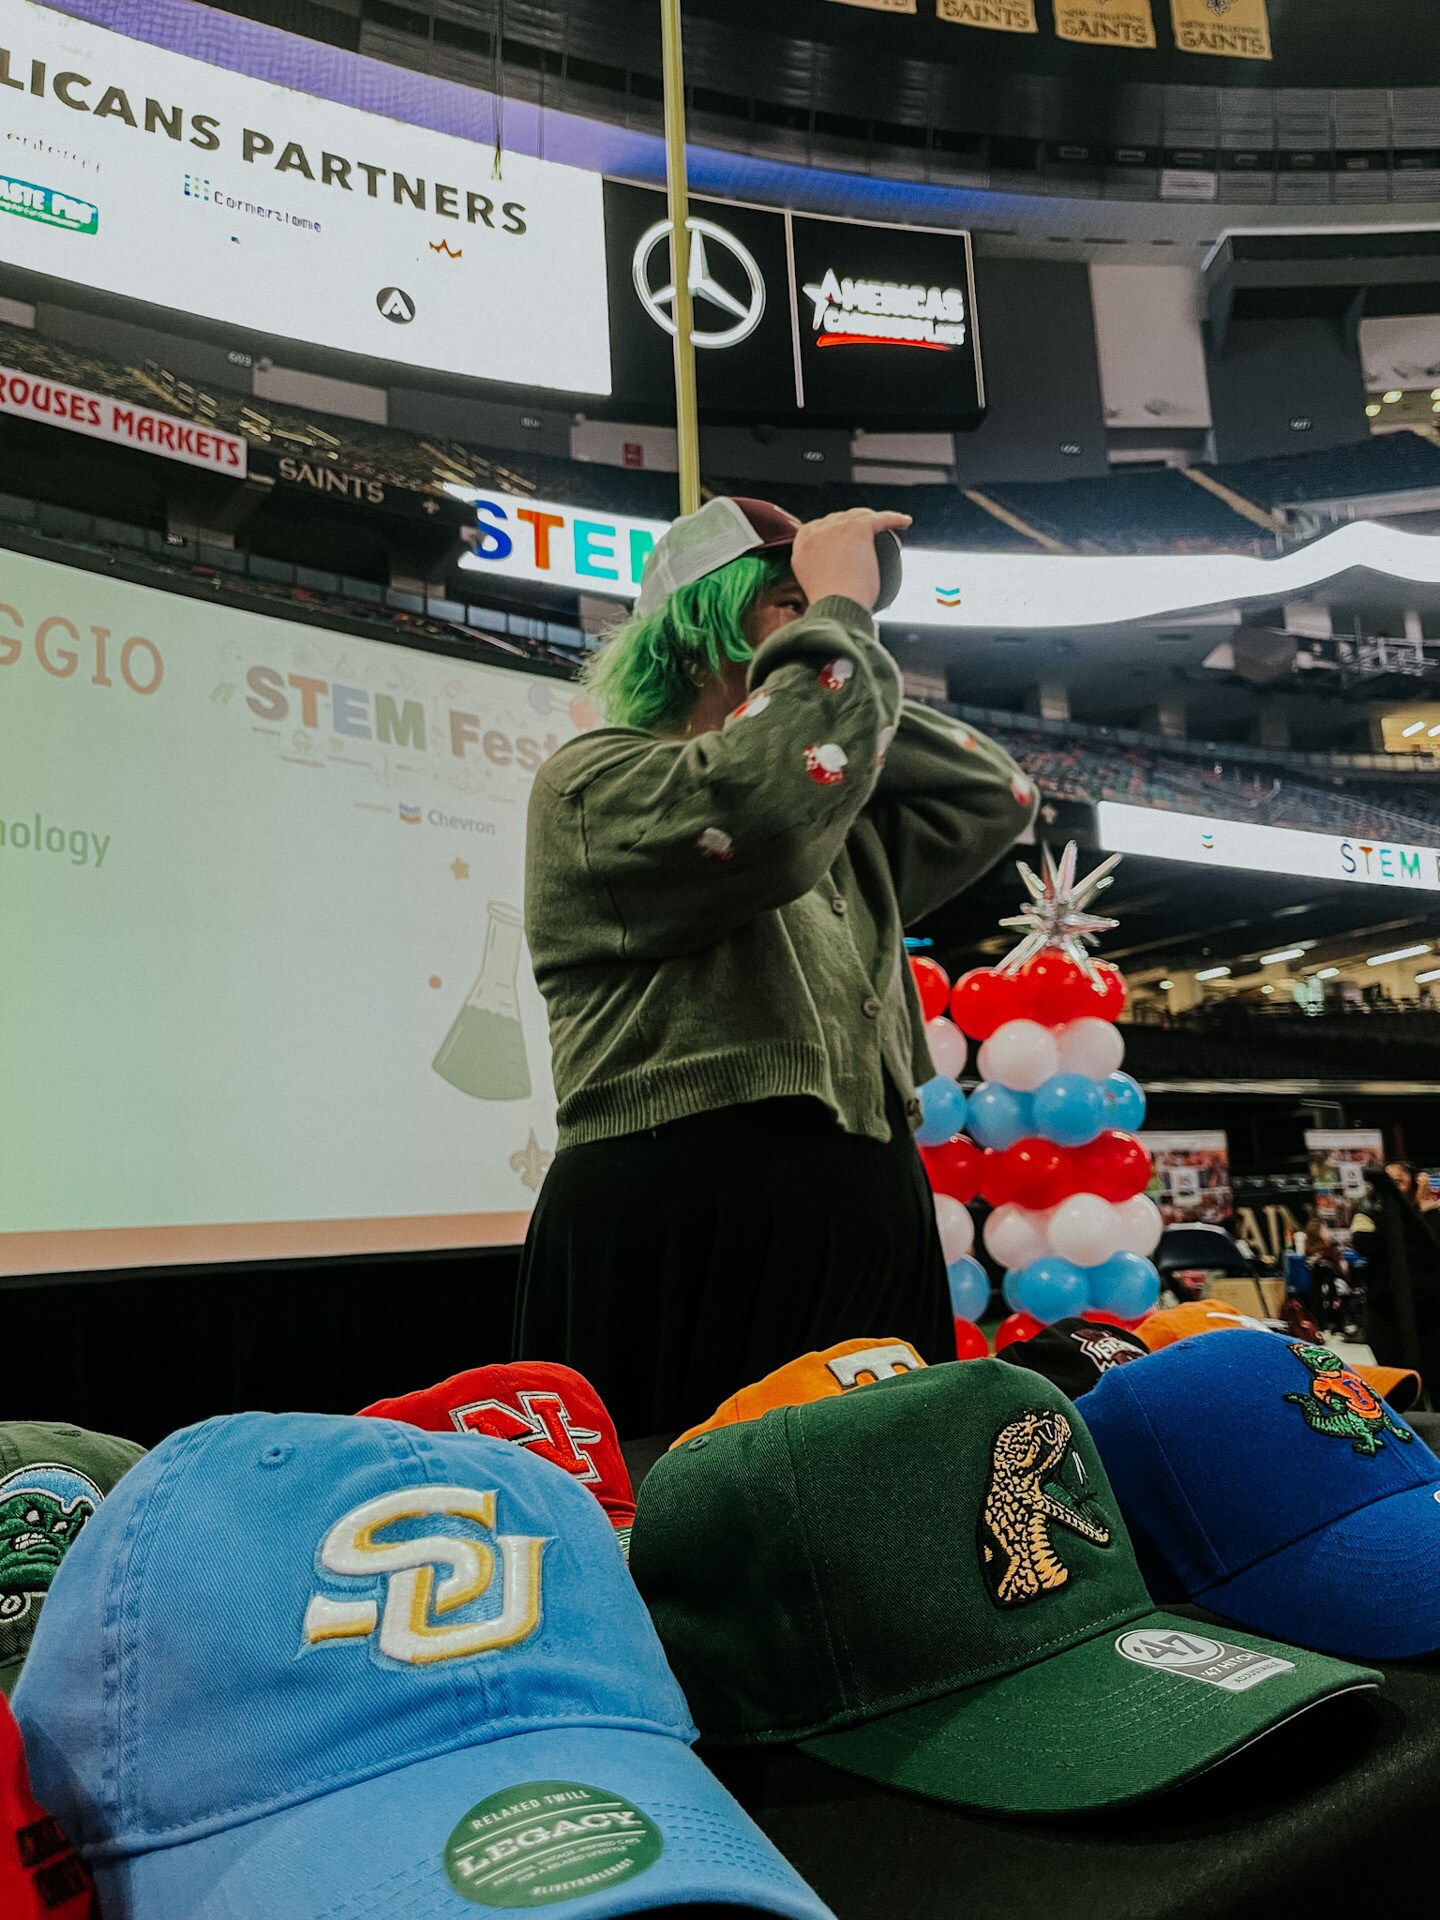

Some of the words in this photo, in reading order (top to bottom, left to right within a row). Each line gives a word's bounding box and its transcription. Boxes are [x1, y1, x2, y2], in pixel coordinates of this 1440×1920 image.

[1061, 19, 1148, 43] SAINTS
[1183, 30, 1265, 55] SAINTS
[0, 47, 220, 150] LICANS
[242, 128, 527, 235] PARTNERS
[112, 406, 241, 467] MARKETS
[279, 458, 385, 503] SAINTS
[246, 667, 427, 750] STEM
[428, 809, 495, 835] Chevron
[1340, 842, 1421, 880] STEM
[1218, 1652, 1259, 1672] HITCH
[472, 1799, 541, 1830] RELAXED
[544, 1789, 591, 1804] TWILL
[456, 1811, 643, 1877] LEGACY
